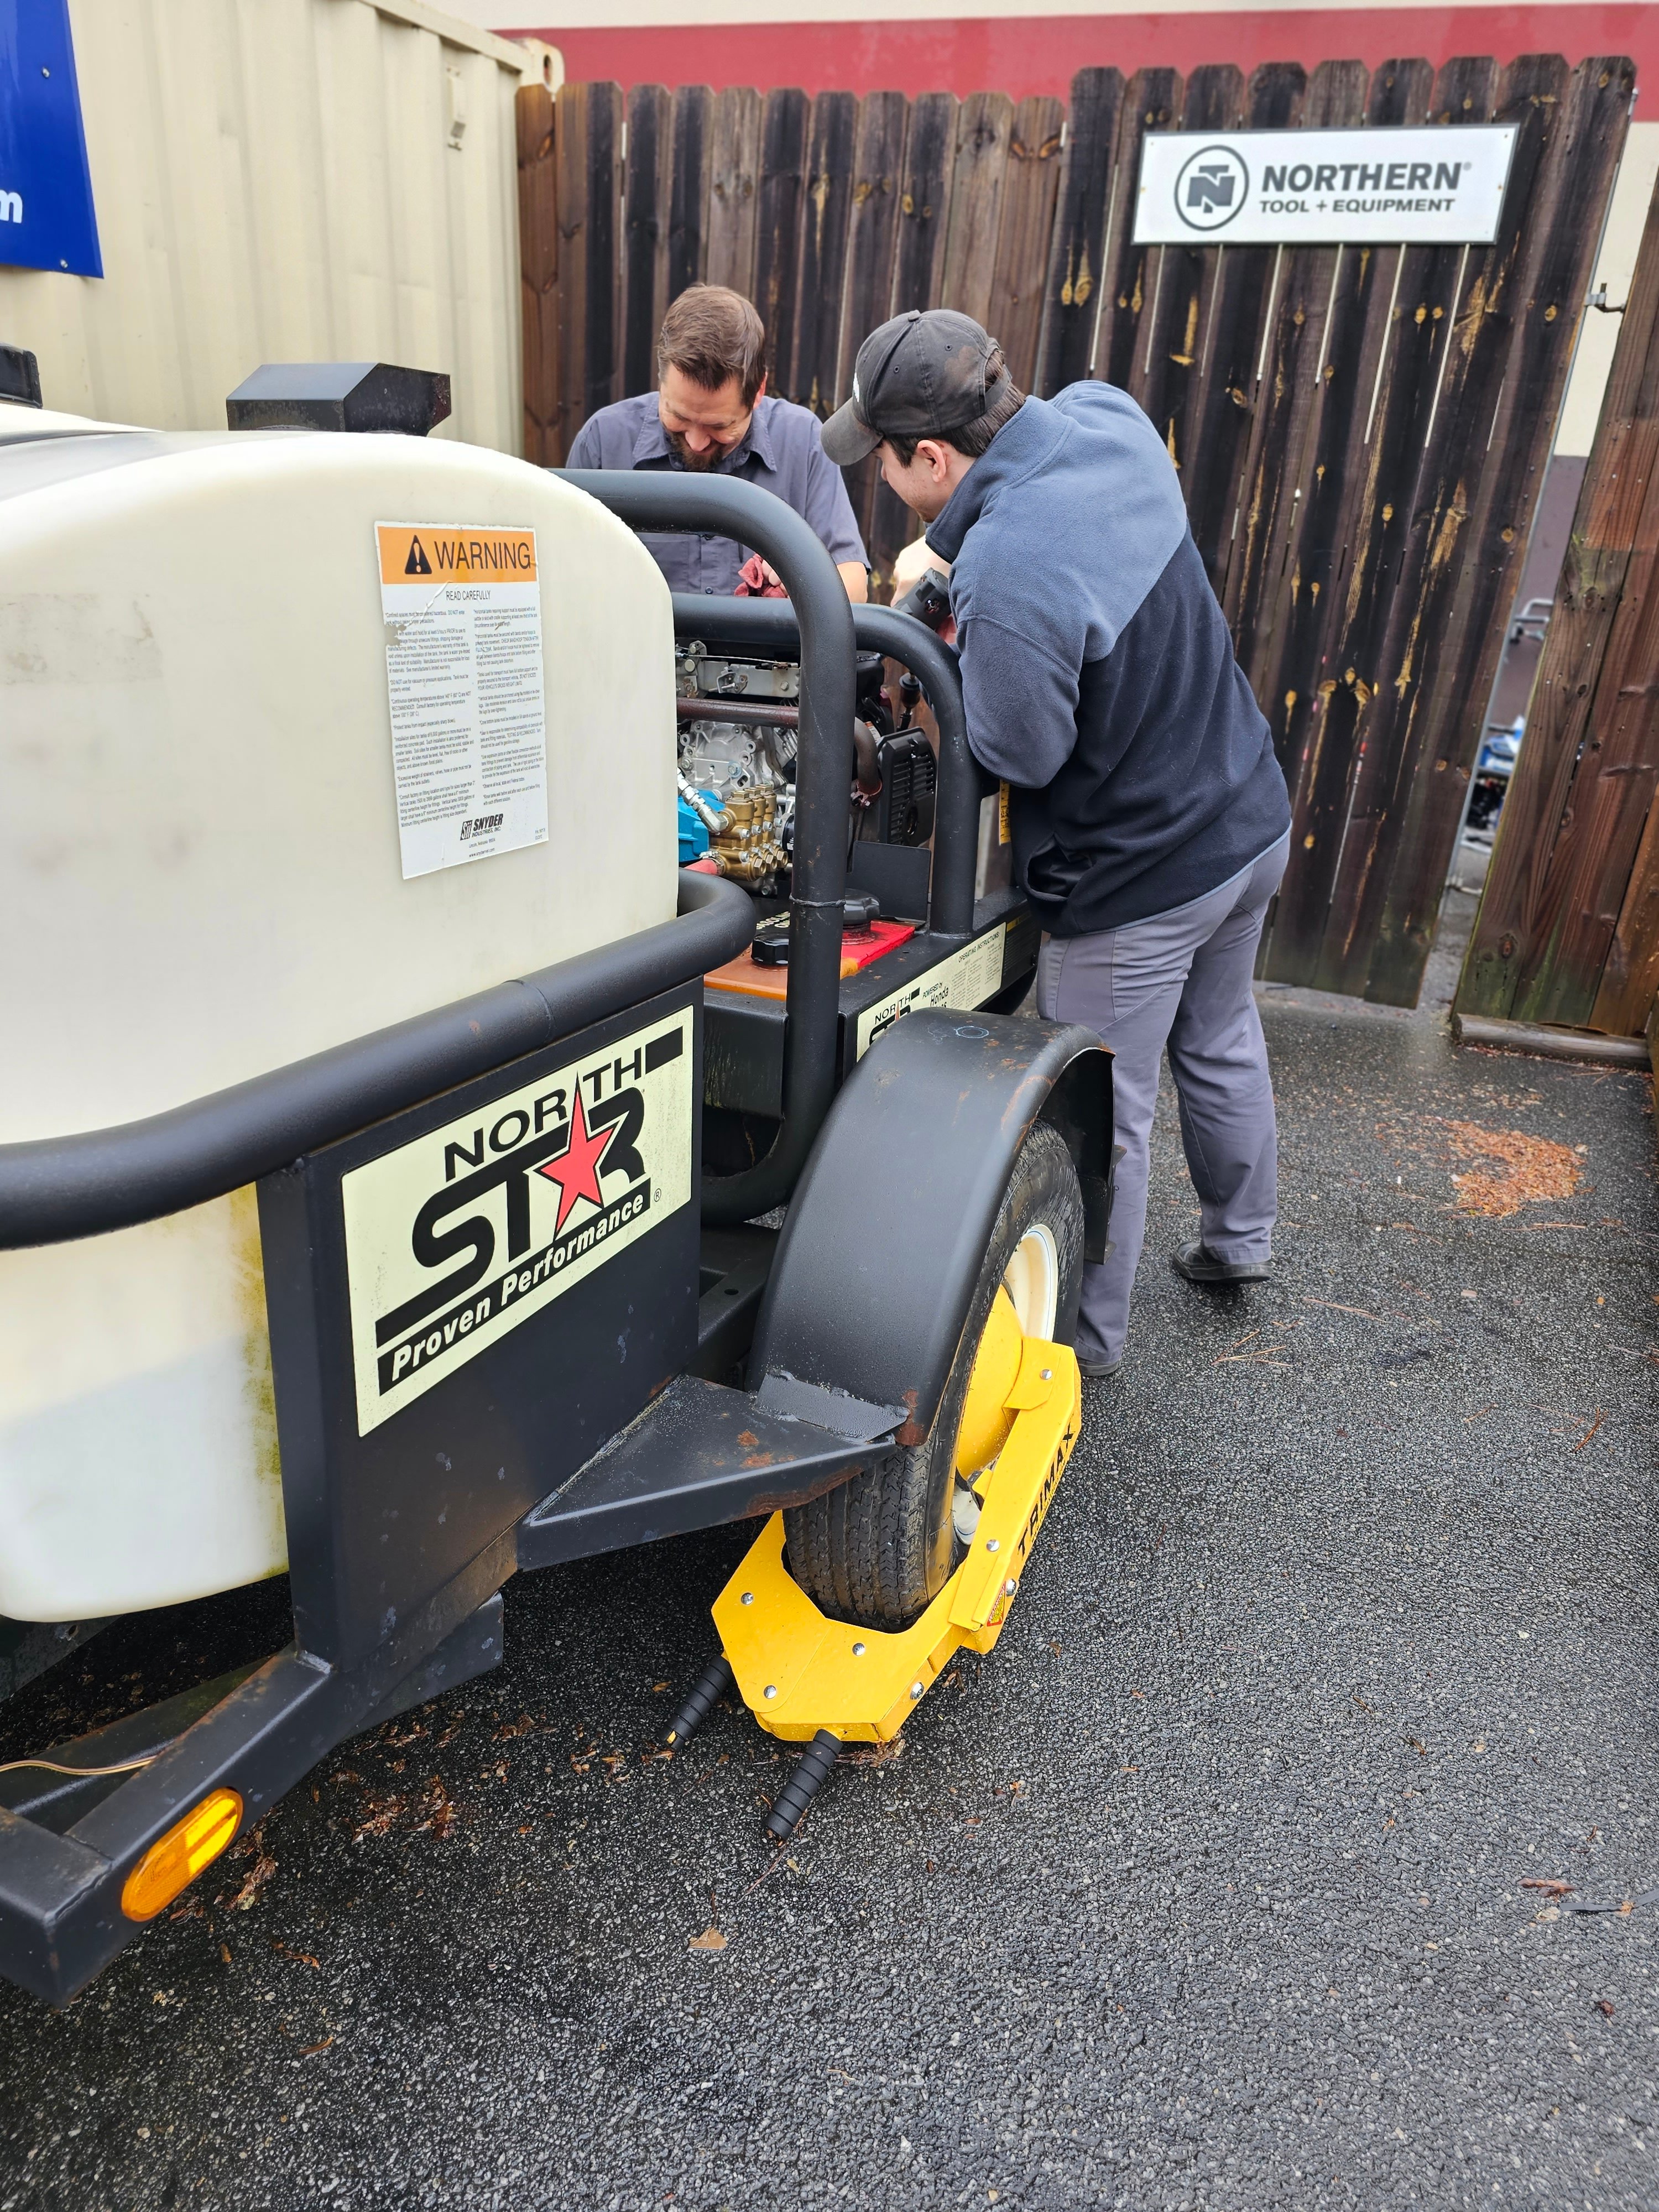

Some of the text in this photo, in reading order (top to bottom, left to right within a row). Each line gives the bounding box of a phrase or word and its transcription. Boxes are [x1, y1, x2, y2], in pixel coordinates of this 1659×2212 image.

[1261, 161, 1462, 192] NORTHERN
[1259, 199, 1310, 214] TOOL
[1332, 199, 1455, 214] EQUIPMENT
[434, 540, 531, 570] WARNING
[446, 590, 491, 601] READ CAREFULLY
[472, 828, 493, 838] INDUSTRIES,
[473, 813, 504, 831] SNYDER
[922, 984, 939, 999] POWERED
[930, 986, 950, 1006] Honda
[875, 993, 911, 1025] NORTH
[445, 1048, 641, 1183] NORTH
[390, 1192, 645, 1381] Proven Performance
[1018, 1422, 1075, 1561] TRIMAX
